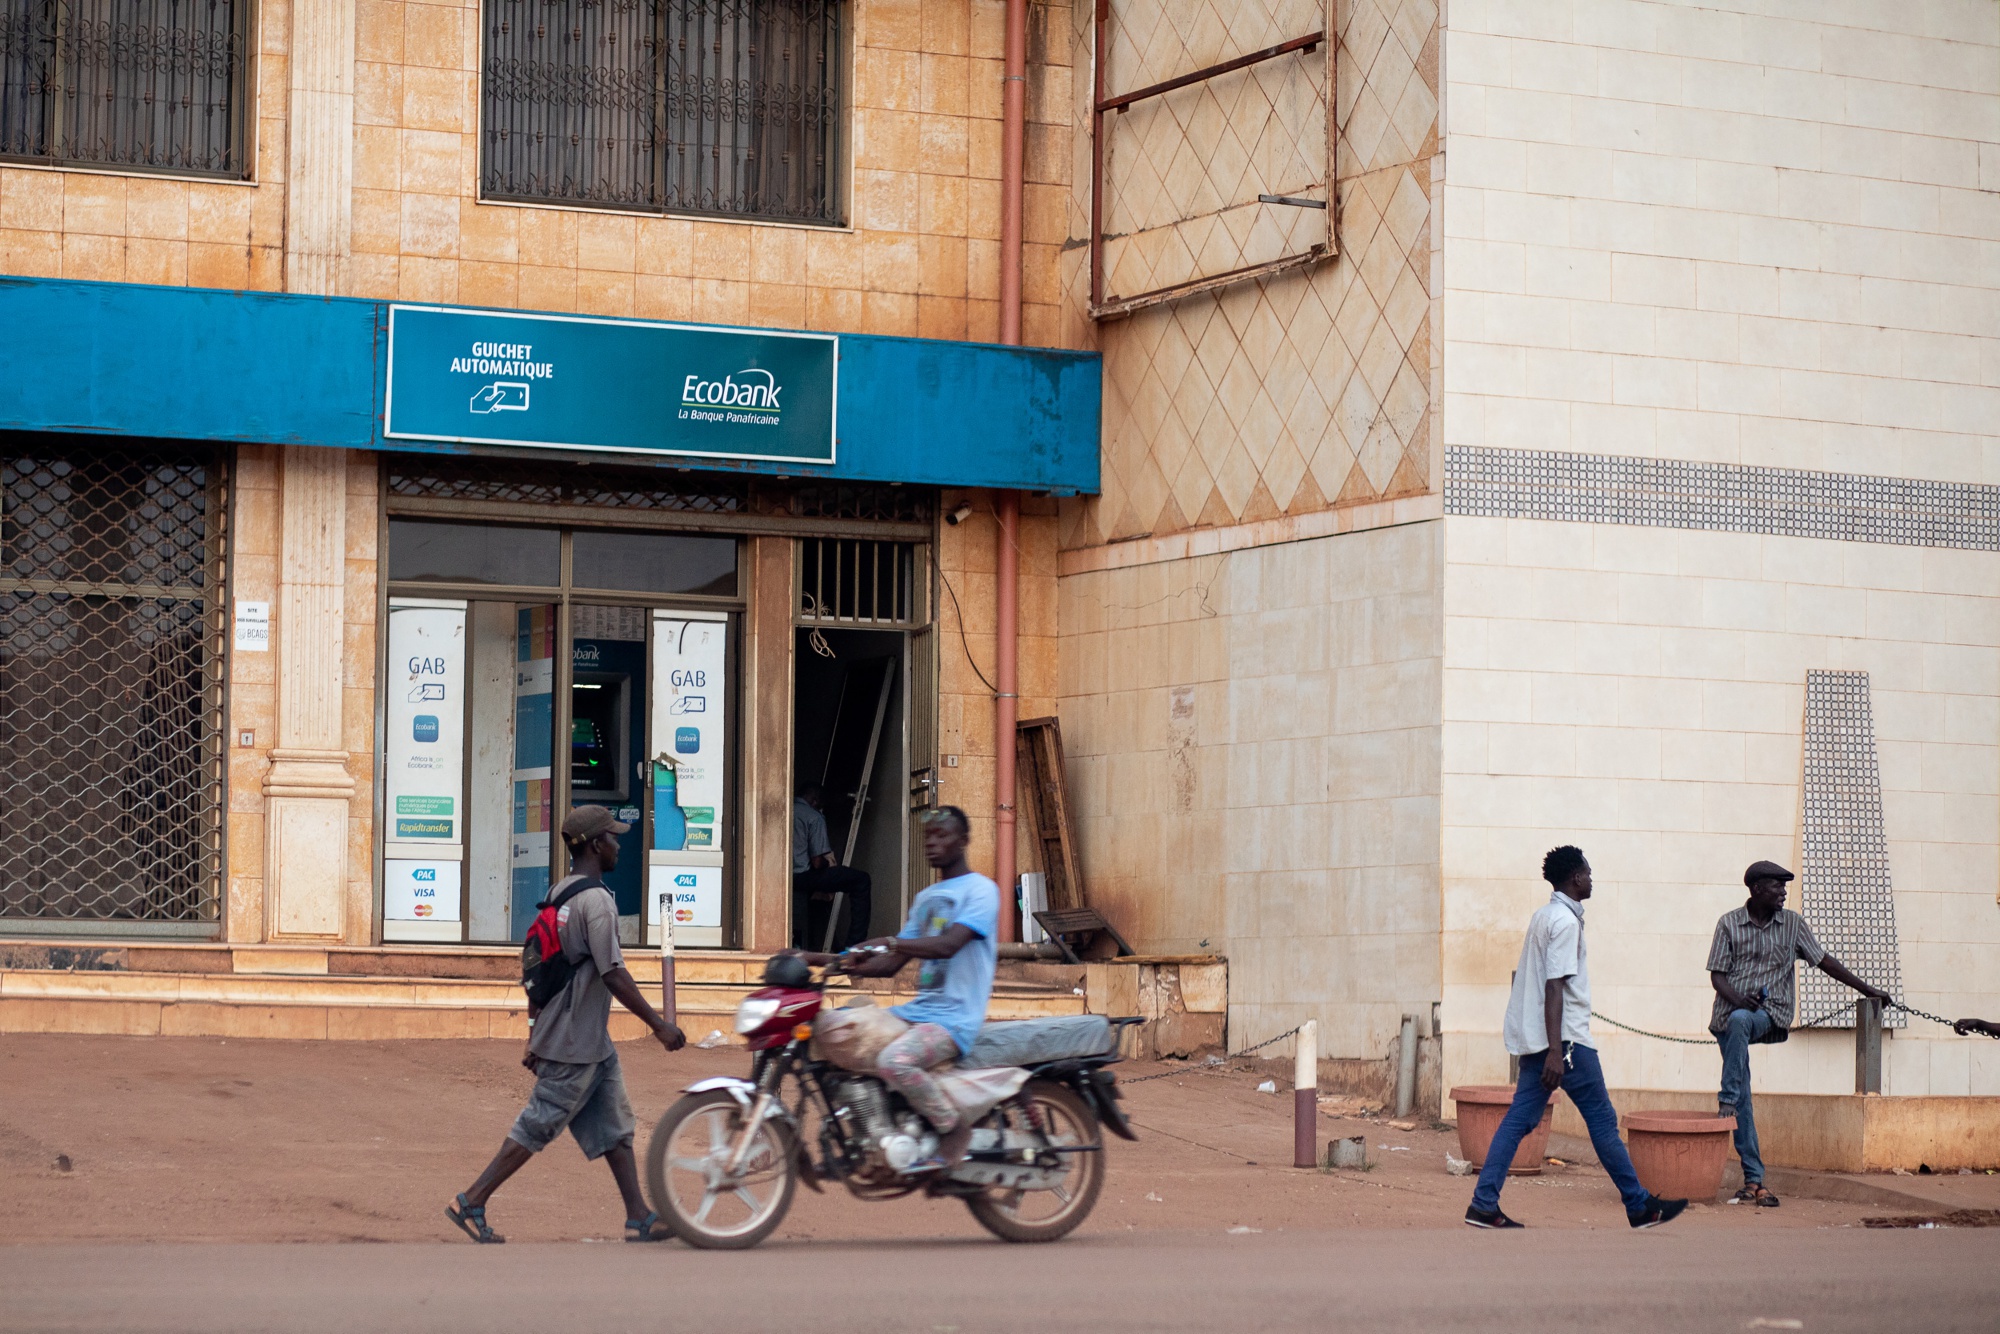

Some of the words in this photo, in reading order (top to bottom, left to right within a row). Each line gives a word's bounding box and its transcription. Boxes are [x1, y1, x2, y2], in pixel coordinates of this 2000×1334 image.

[472, 341, 533, 360] GUICHET
[450, 357, 554, 380] AUTOMATIQUE
[682, 368, 782, 408] Ecobank
[678, 408, 688, 419] La
[690, 409, 724, 423] Banque
[726, 411, 780, 425] Panafricaine
[247, 628, 268, 639] BCAGS
[572, 644, 601, 660] obank
[409, 656, 446, 675] GAB
[671, 669, 706, 688] GAB
[415, 722, 437, 731] Ecobank
[677, 733, 698, 742] Ecobank
[400, 822, 450, 834] Rapidtransfer
[416, 870, 434, 880] PAC
[678, 876, 695, 886] PAC
[413, 888, 436, 897] VISA
[676, 893, 696, 902] VISA
